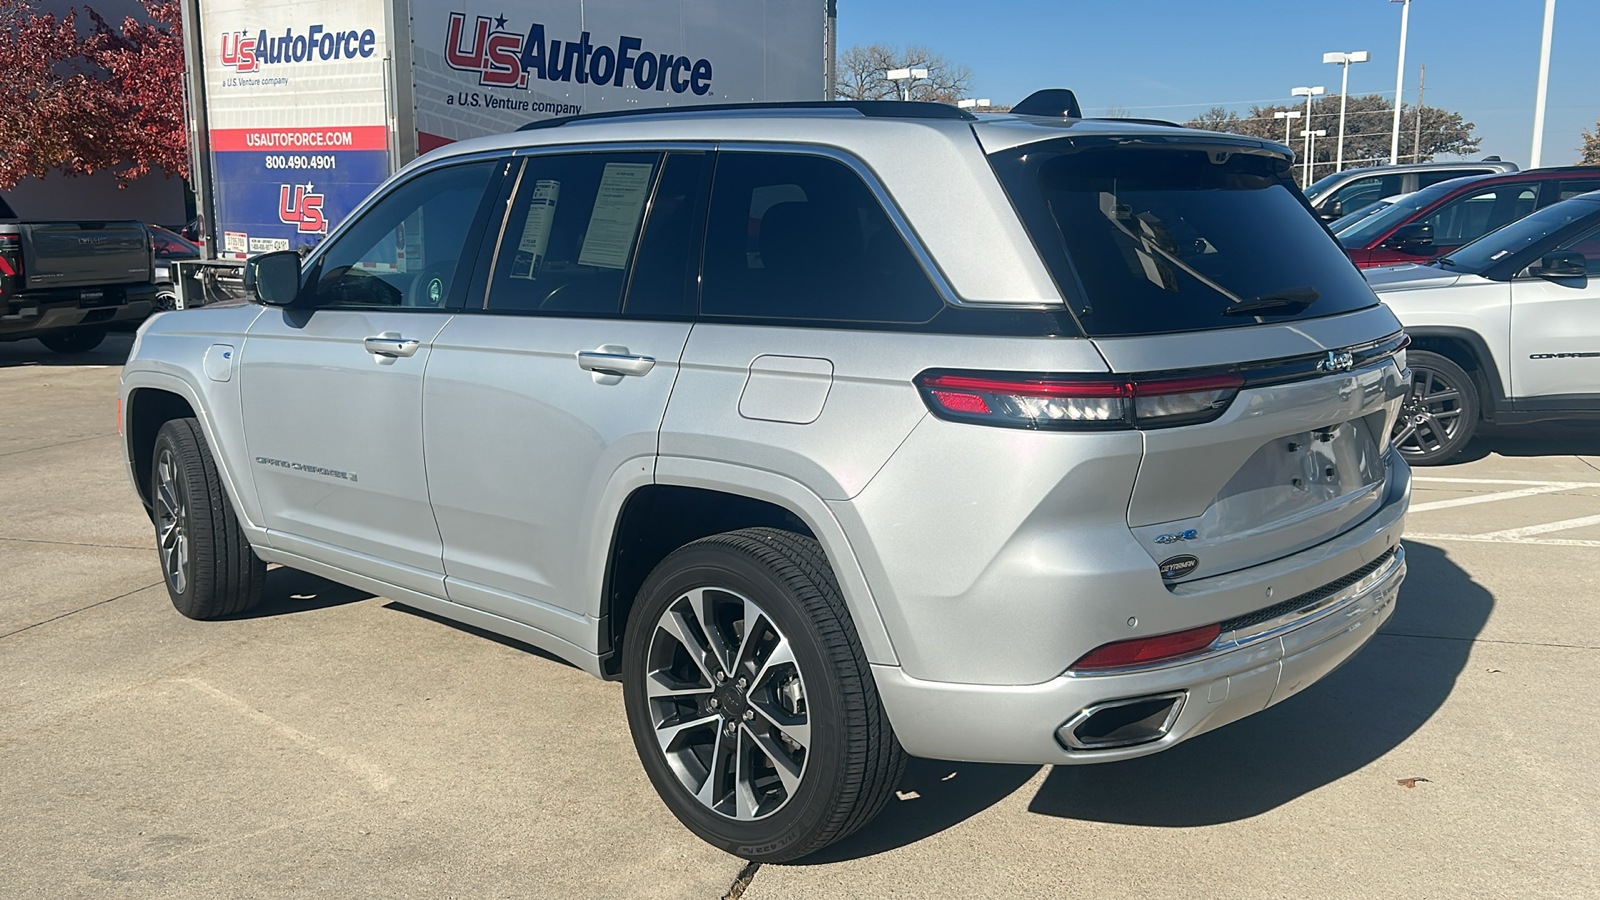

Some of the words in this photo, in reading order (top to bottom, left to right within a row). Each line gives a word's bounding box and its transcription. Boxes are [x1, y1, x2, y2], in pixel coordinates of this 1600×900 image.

[256, 24, 375, 64] AutoForce
[520, 23, 712, 96] AutoForce
[238, 78, 260, 86] Venture
[261, 77, 288, 86] company
[447, 95, 454, 105] a
[458, 92, 482, 108] U.S.
[484, 94, 529, 111] Venture
[531, 101, 582, 116] company
[246, 132, 353, 147] USAUTOFORCE.COM
[265, 155, 336, 169] 800.490.4901
